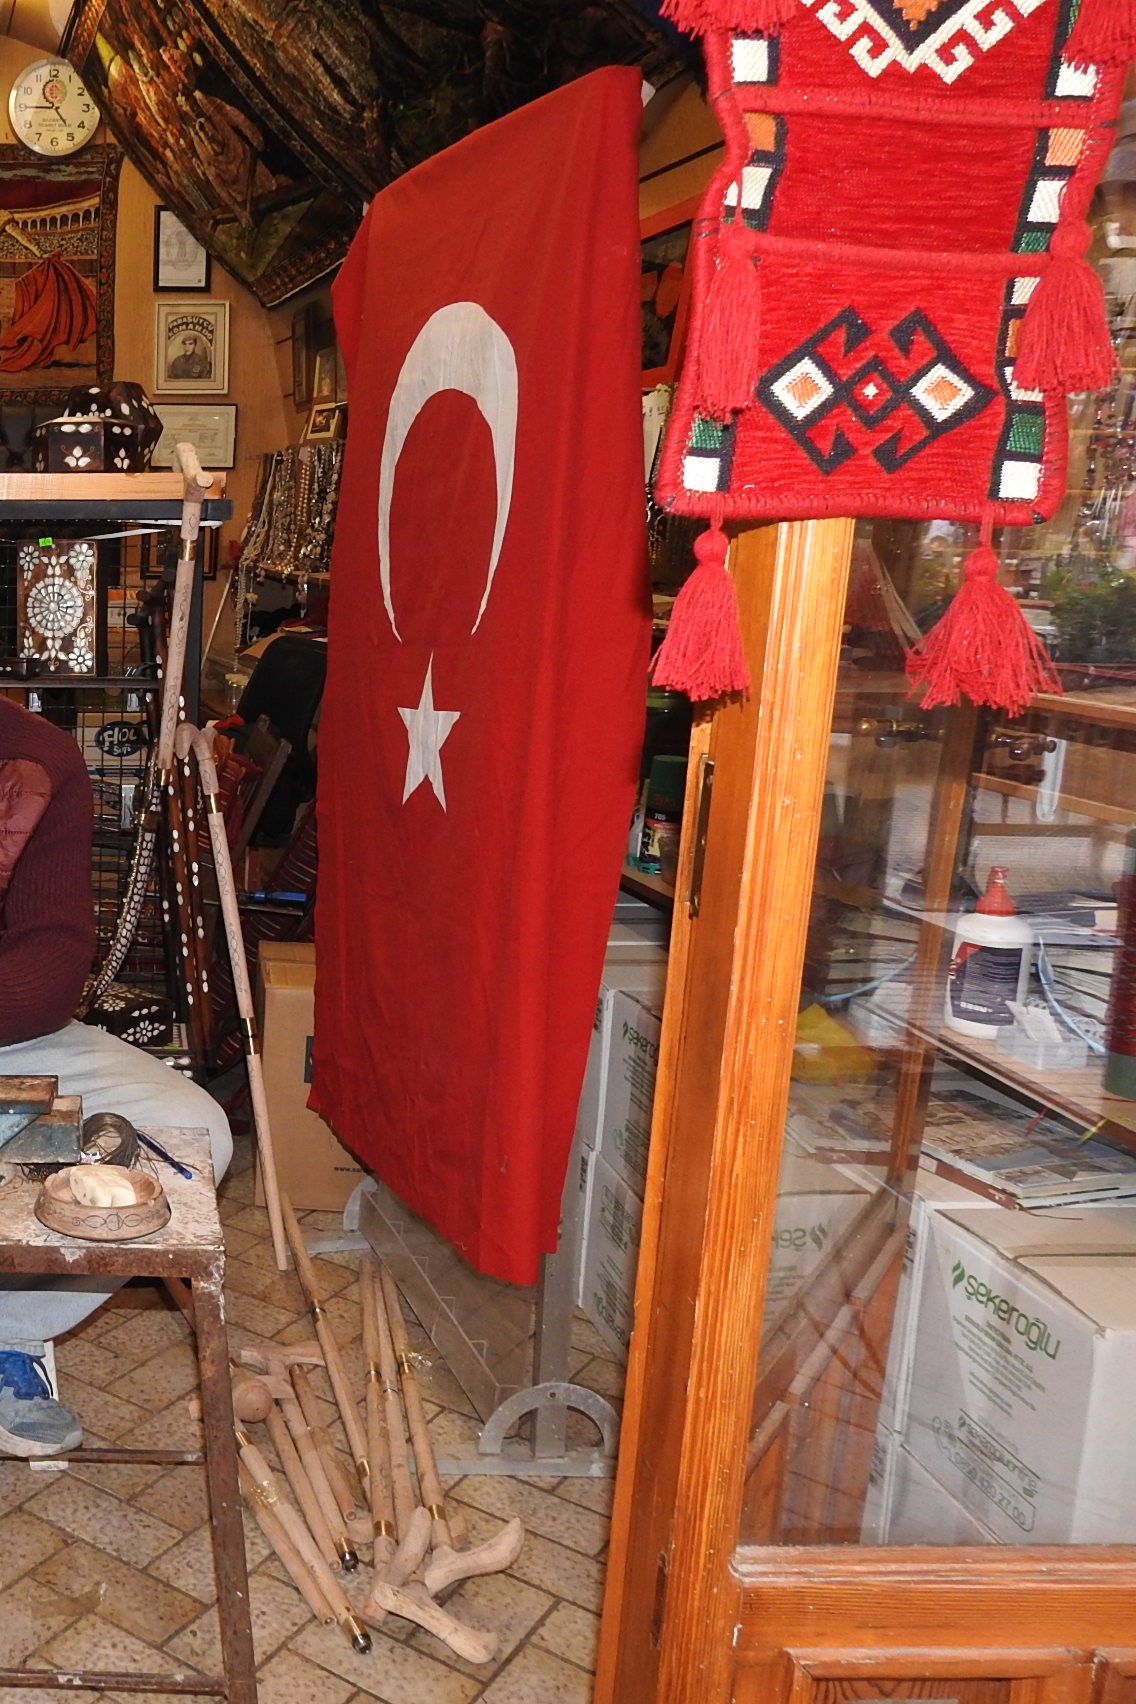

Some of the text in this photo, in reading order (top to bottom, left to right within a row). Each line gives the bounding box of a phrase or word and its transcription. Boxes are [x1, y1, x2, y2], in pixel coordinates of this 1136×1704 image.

[49, 69, 60, 79] 12
[36, 75, 42, 83] 11
[69, 75, 72, 83] 1
[24, 87, 33, 95] 10
[77, 88, 85, 96] 2
[19, 104, 26, 112] 9
[82, 104, 91, 112] 3
[77, 121, 86, 129] 4
[35, 133, 42, 141] 7
[66, 133, 75, 141] 5
[50, 138, 59, 146] 6
[964, 1274, 1061, 1360] şekeroğlu
